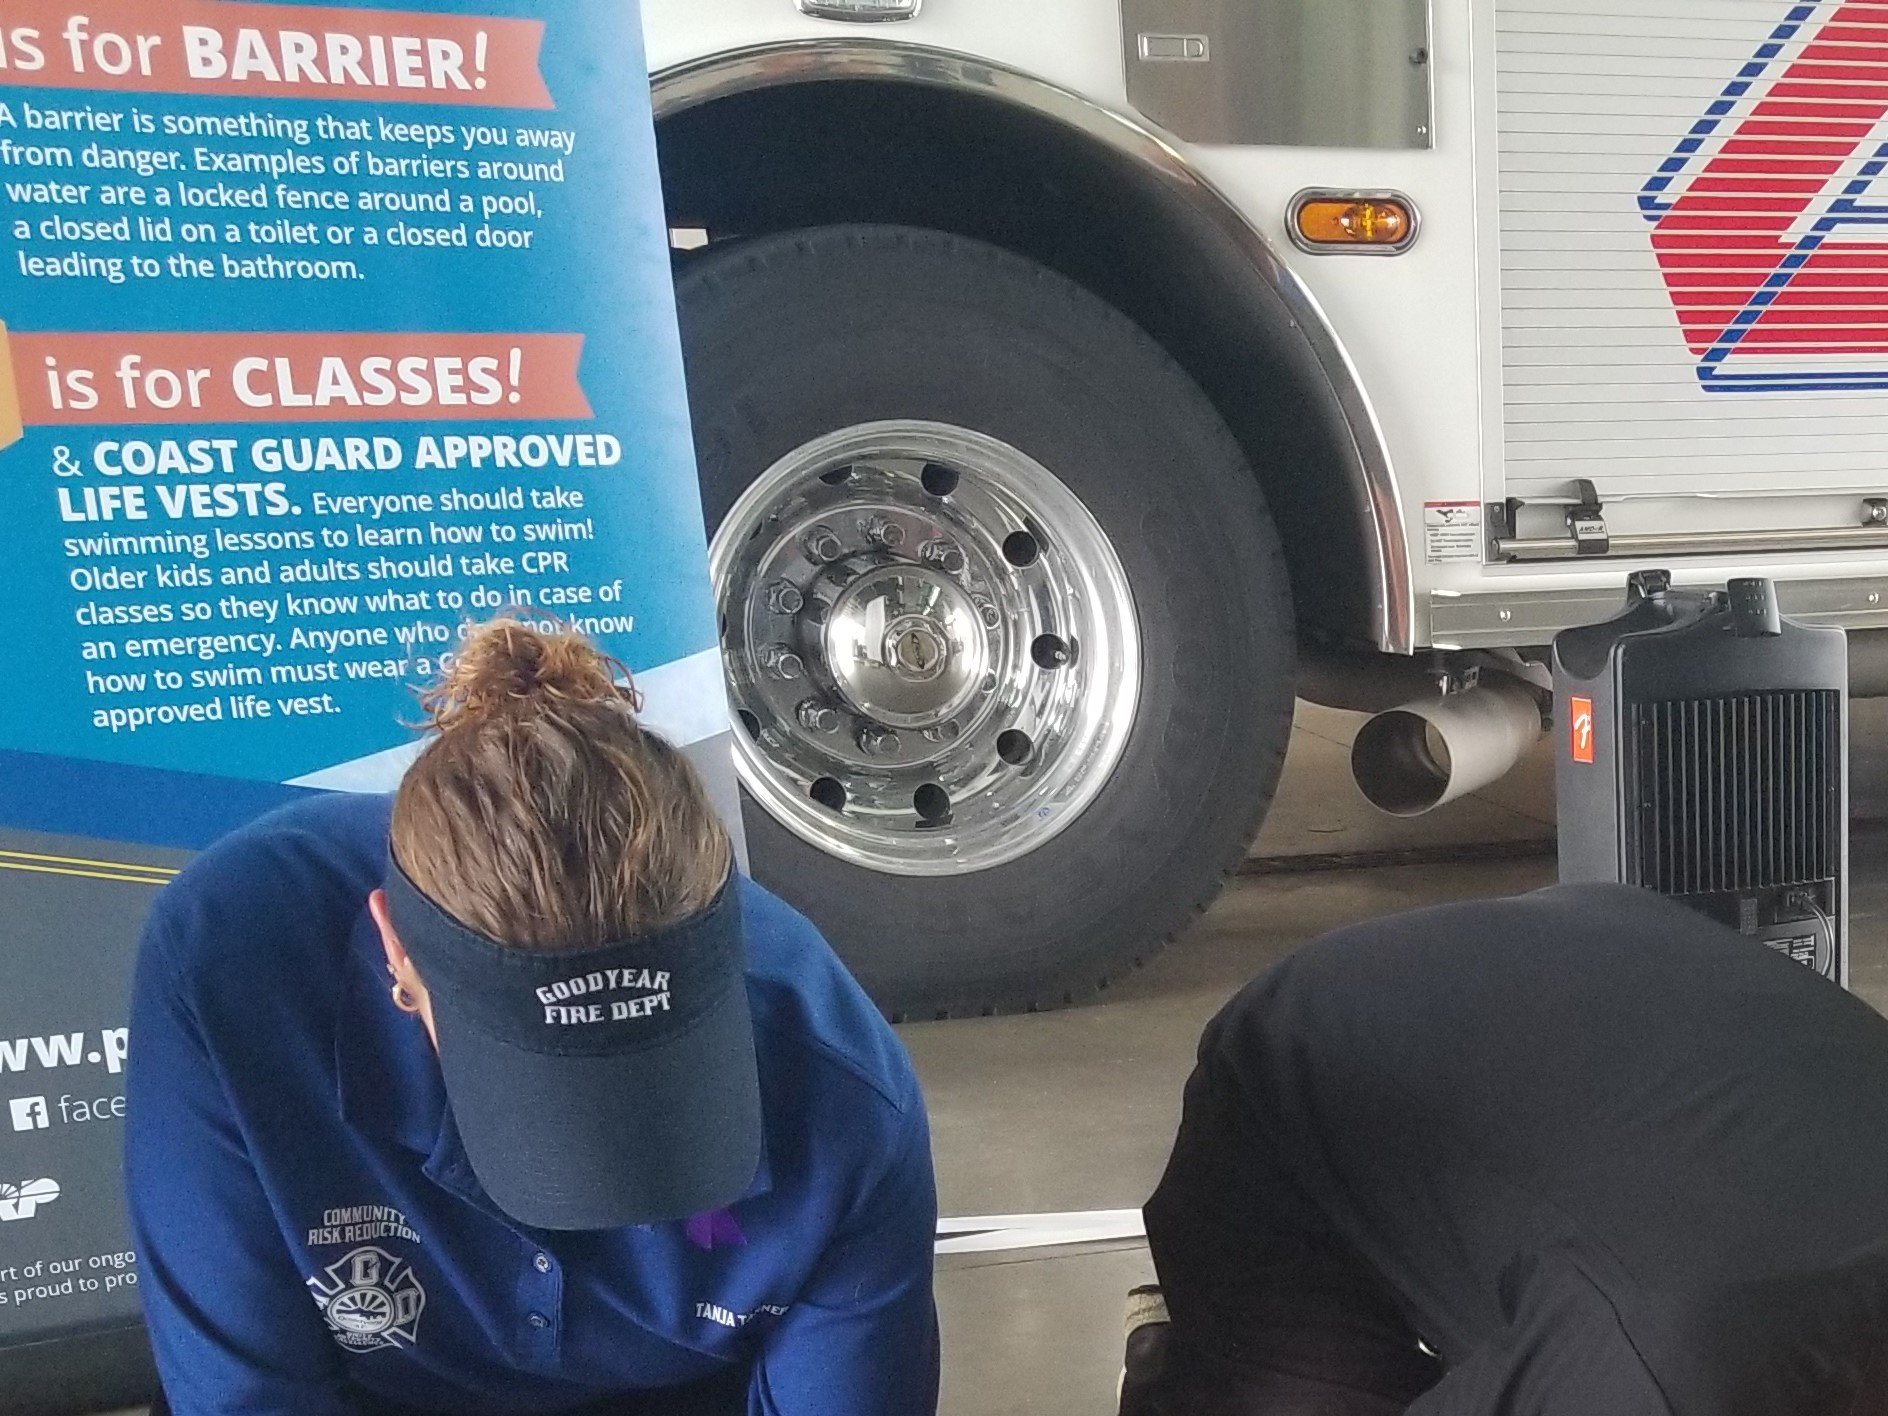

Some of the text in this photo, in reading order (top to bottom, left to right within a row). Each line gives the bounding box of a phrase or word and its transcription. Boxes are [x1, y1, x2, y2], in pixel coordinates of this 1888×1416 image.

[61, 14, 162, 77] for
[181, 24, 488, 91] BARRIER!
[0, 102, 576, 156] A barrier is something that keeps you away
[0, 139, 565, 182] from danger. Examples of barriers around
[6, 181, 542, 220] water are a locked fence around a pool,
[14, 215, 533, 248] a closed lid on a toilet or a closed door
[18, 250, 364, 284] leading to the bathroom.
[44, 347, 522, 410] is for CLASSES!
[53, 434, 622, 477] & COAST GUARD APPROVED
[57, 482, 583, 522] LIFE VESTS. Everyone should take
[64, 518, 594, 559] swimming lessons to learn how to swim!
[70, 551, 569, 591] Older kids and adults should take CPR
[76, 579, 622, 625] classes so they know what to do in case of
[82, 641, 116, 660] an
[125, 633, 282, 660] emergency.
[290, 624, 387, 653] Anyone
[394, 620, 450, 643] who
[570, 613, 634, 636] know
[86, 670, 146, 694] how
[153, 670, 183, 689] to
[191, 663, 262, 688] swim
[270, 660, 339, 683] must
[344, 659, 409, 678] wear
[416, 657, 432, 675] a
[93, 694, 340, 733] approved life vest.
[535, 968, 671, 1005] GOODYEAR
[544, 991, 671, 1025] FIRE DEPT
[58, 1094, 126, 1124] face
[307, 1221, 422, 1246] RISK REDUCTION
[323, 1204, 407, 1227] COMMUNITY
[23, 1260, 44, 1279] of
[49, 1258, 83, 1275] our
[88, 1251, 137, 1270] ongo
[14, 1278, 74, 1306] proud
[78, 1278, 99, 1292] to
[104, 1272, 138, 1293] pro
[695, 1301, 736, 1329] TANJA
